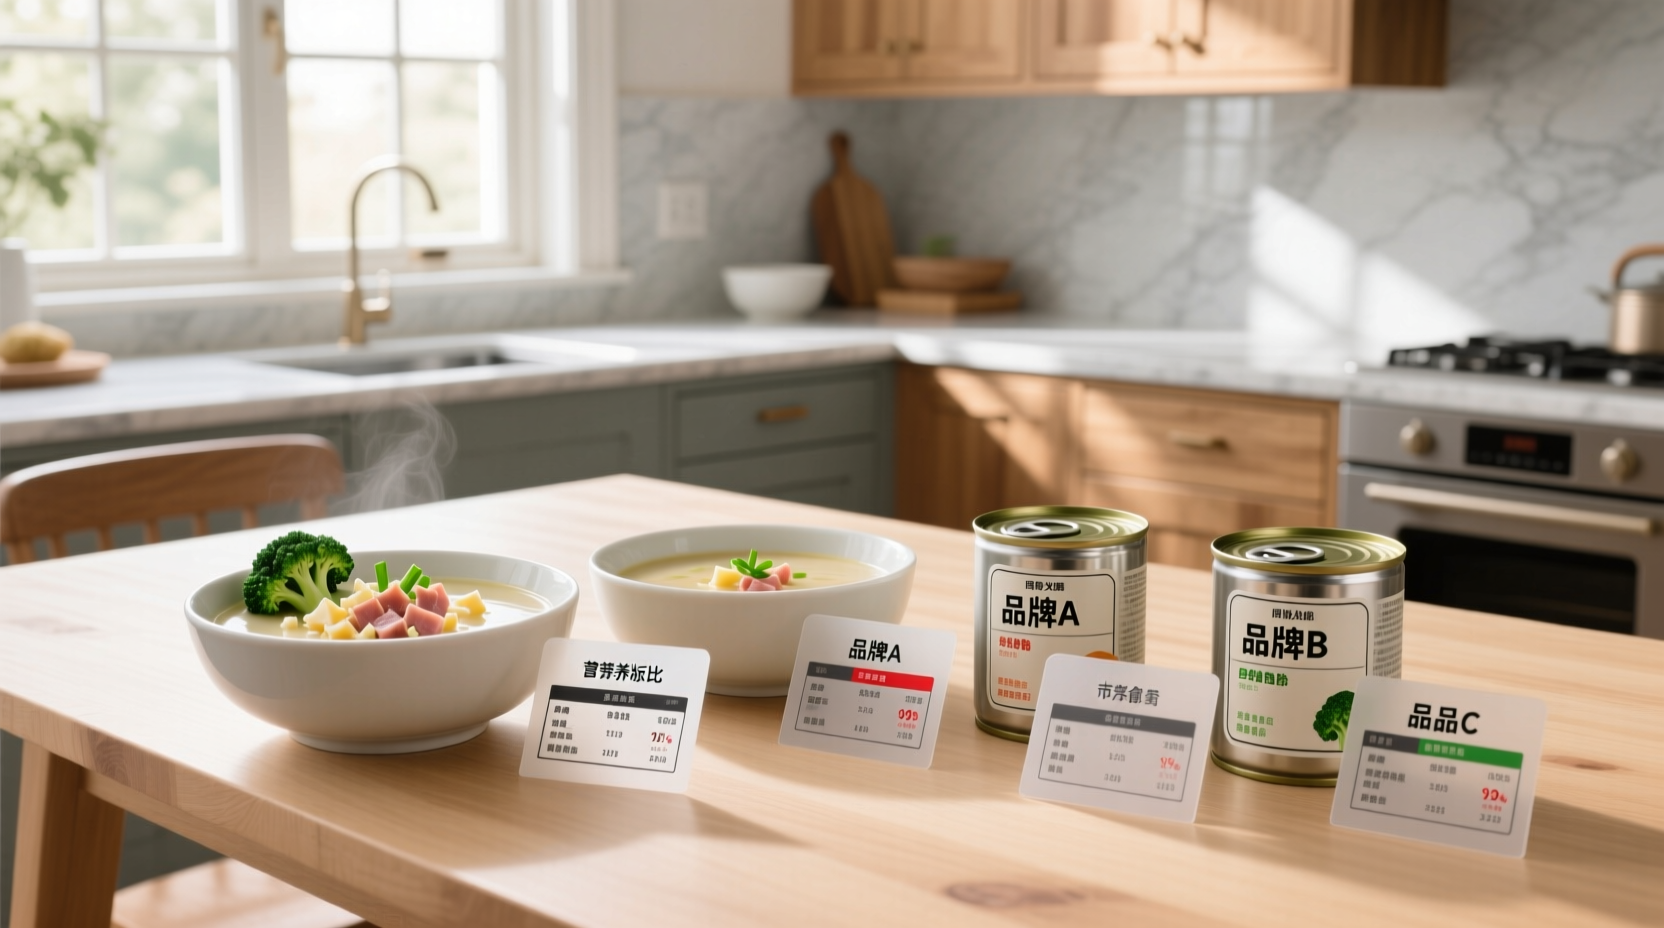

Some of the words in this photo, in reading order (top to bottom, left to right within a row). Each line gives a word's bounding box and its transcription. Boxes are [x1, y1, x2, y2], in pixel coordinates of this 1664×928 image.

[1002, 594, 1080, 629] 品牌A
[848, 638, 901, 663] 品牌A
[1242, 622, 1328, 661] 品牌B
[1407, 702, 1481, 735] 品品C
